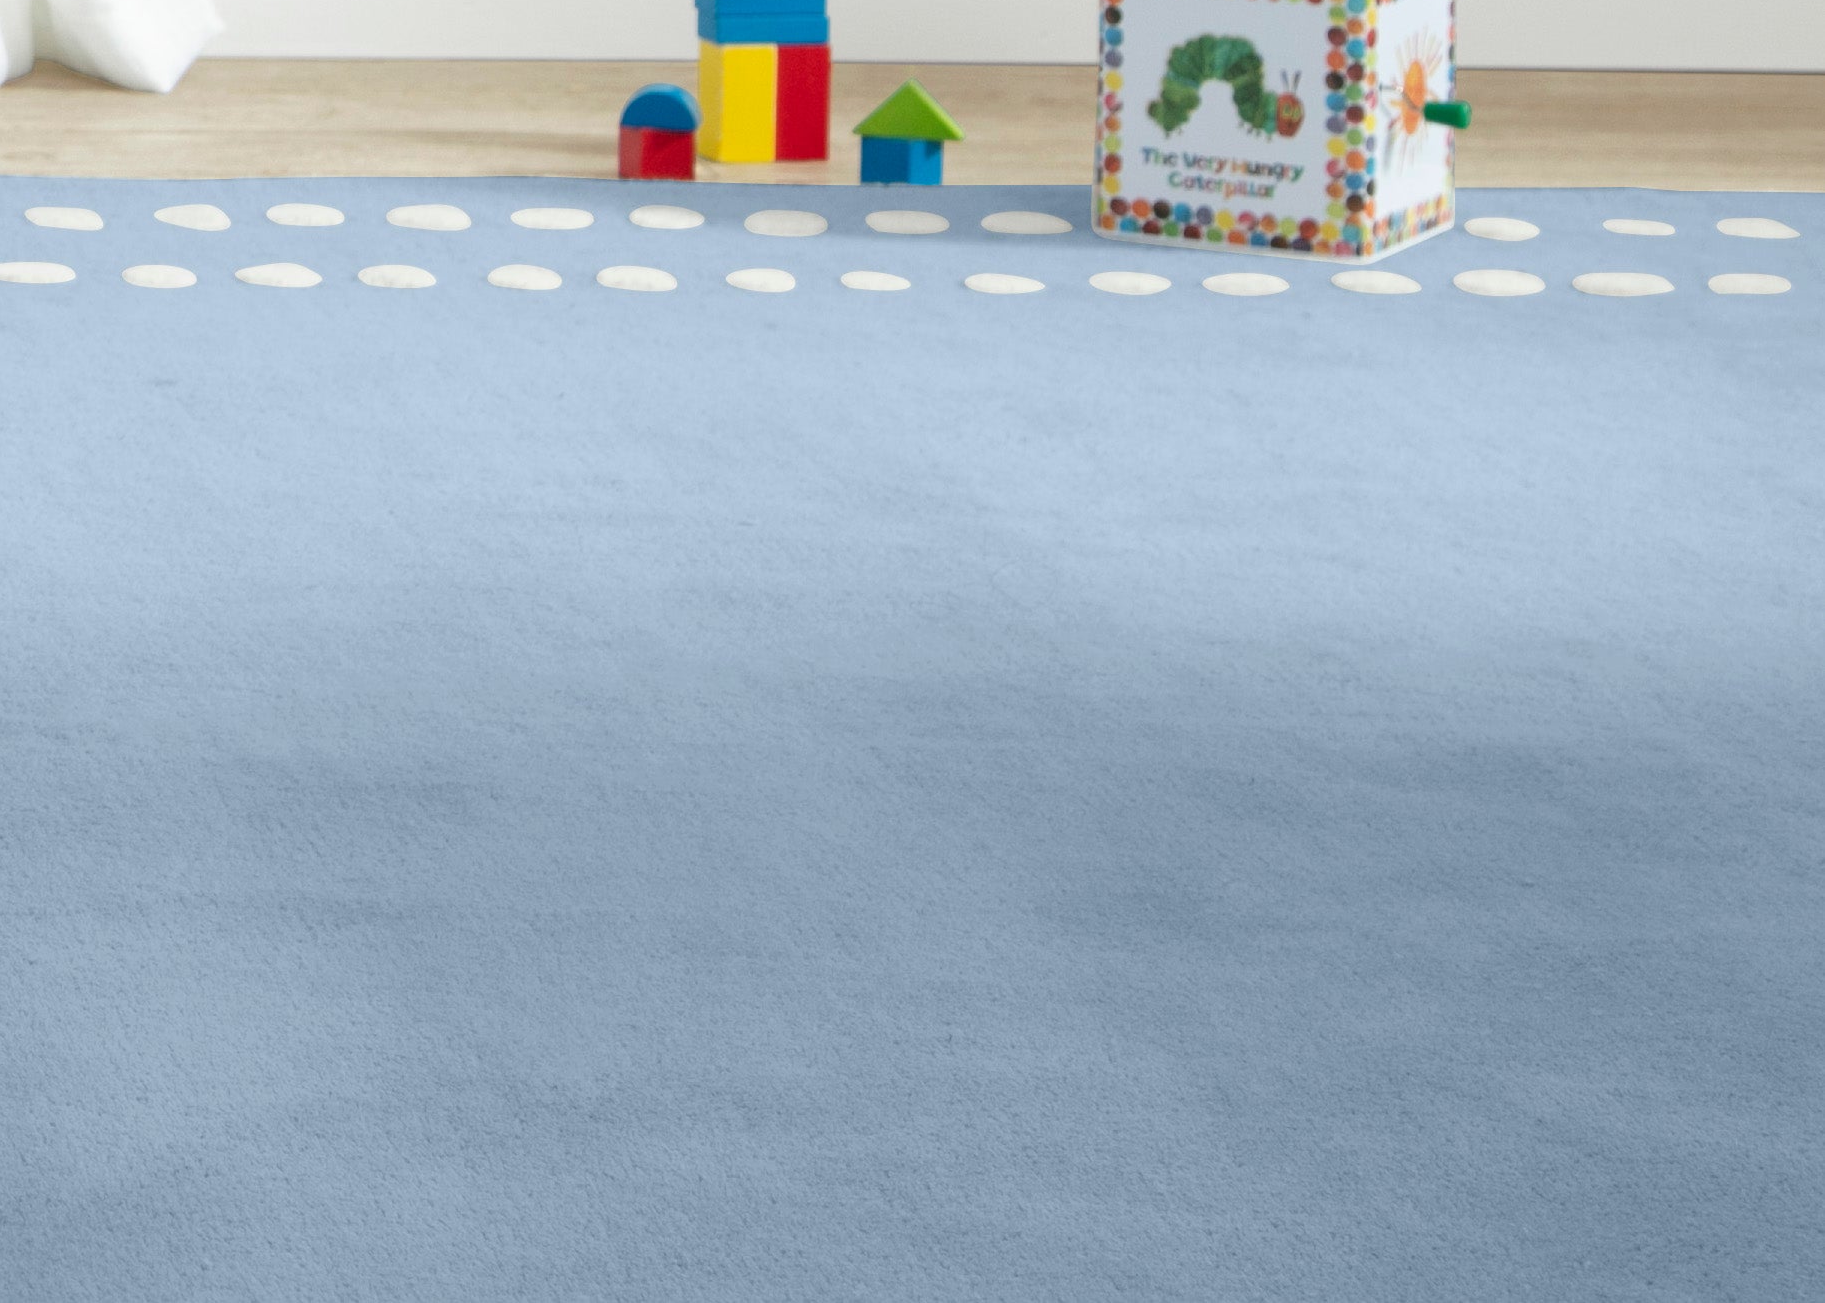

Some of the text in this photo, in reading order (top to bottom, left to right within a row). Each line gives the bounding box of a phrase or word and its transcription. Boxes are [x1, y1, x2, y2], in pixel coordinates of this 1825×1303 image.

[1142, 146, 1304, 183] The Very Hungry
[1168, 171, 1275, 200] Caterpillar
